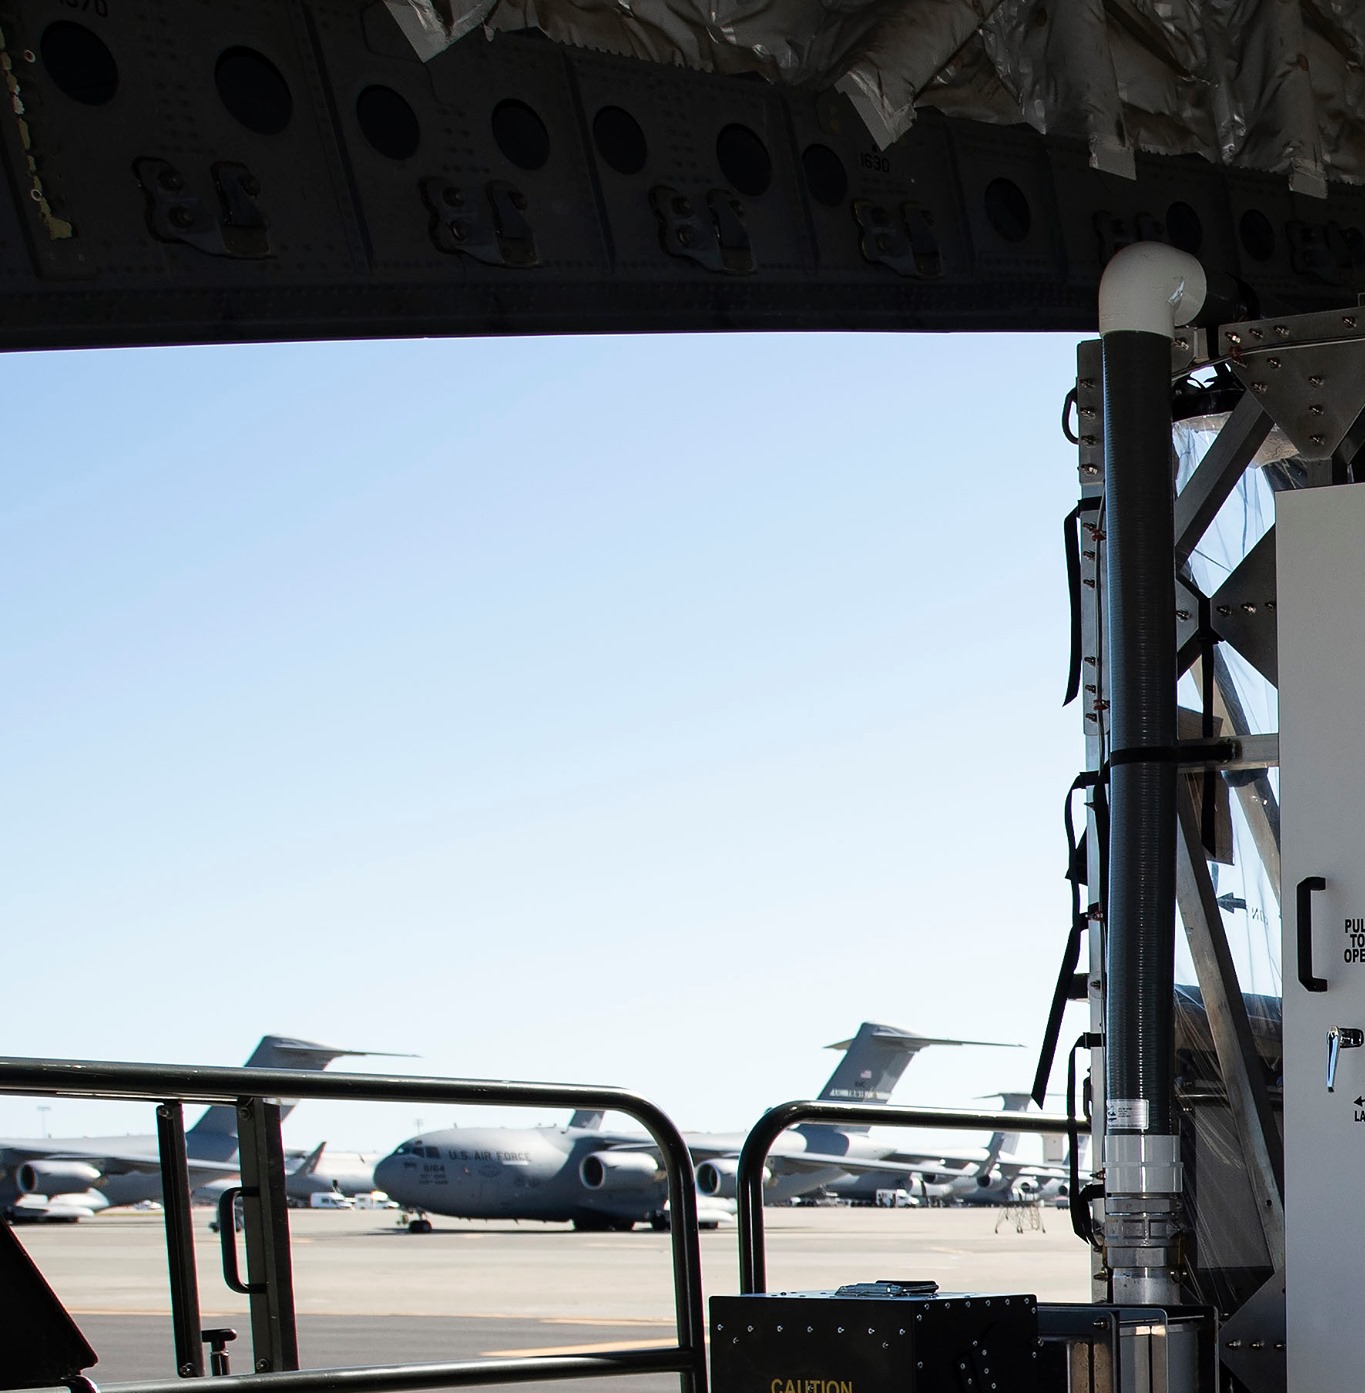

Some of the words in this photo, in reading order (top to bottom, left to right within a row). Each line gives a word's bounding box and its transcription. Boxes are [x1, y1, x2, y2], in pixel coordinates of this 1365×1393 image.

[861, 153, 890, 173] 1630
[1350, 933, 1365, 948] TO
[474, 1151, 492, 1161] AIR
[495, 1151, 531, 1162] FORCE
